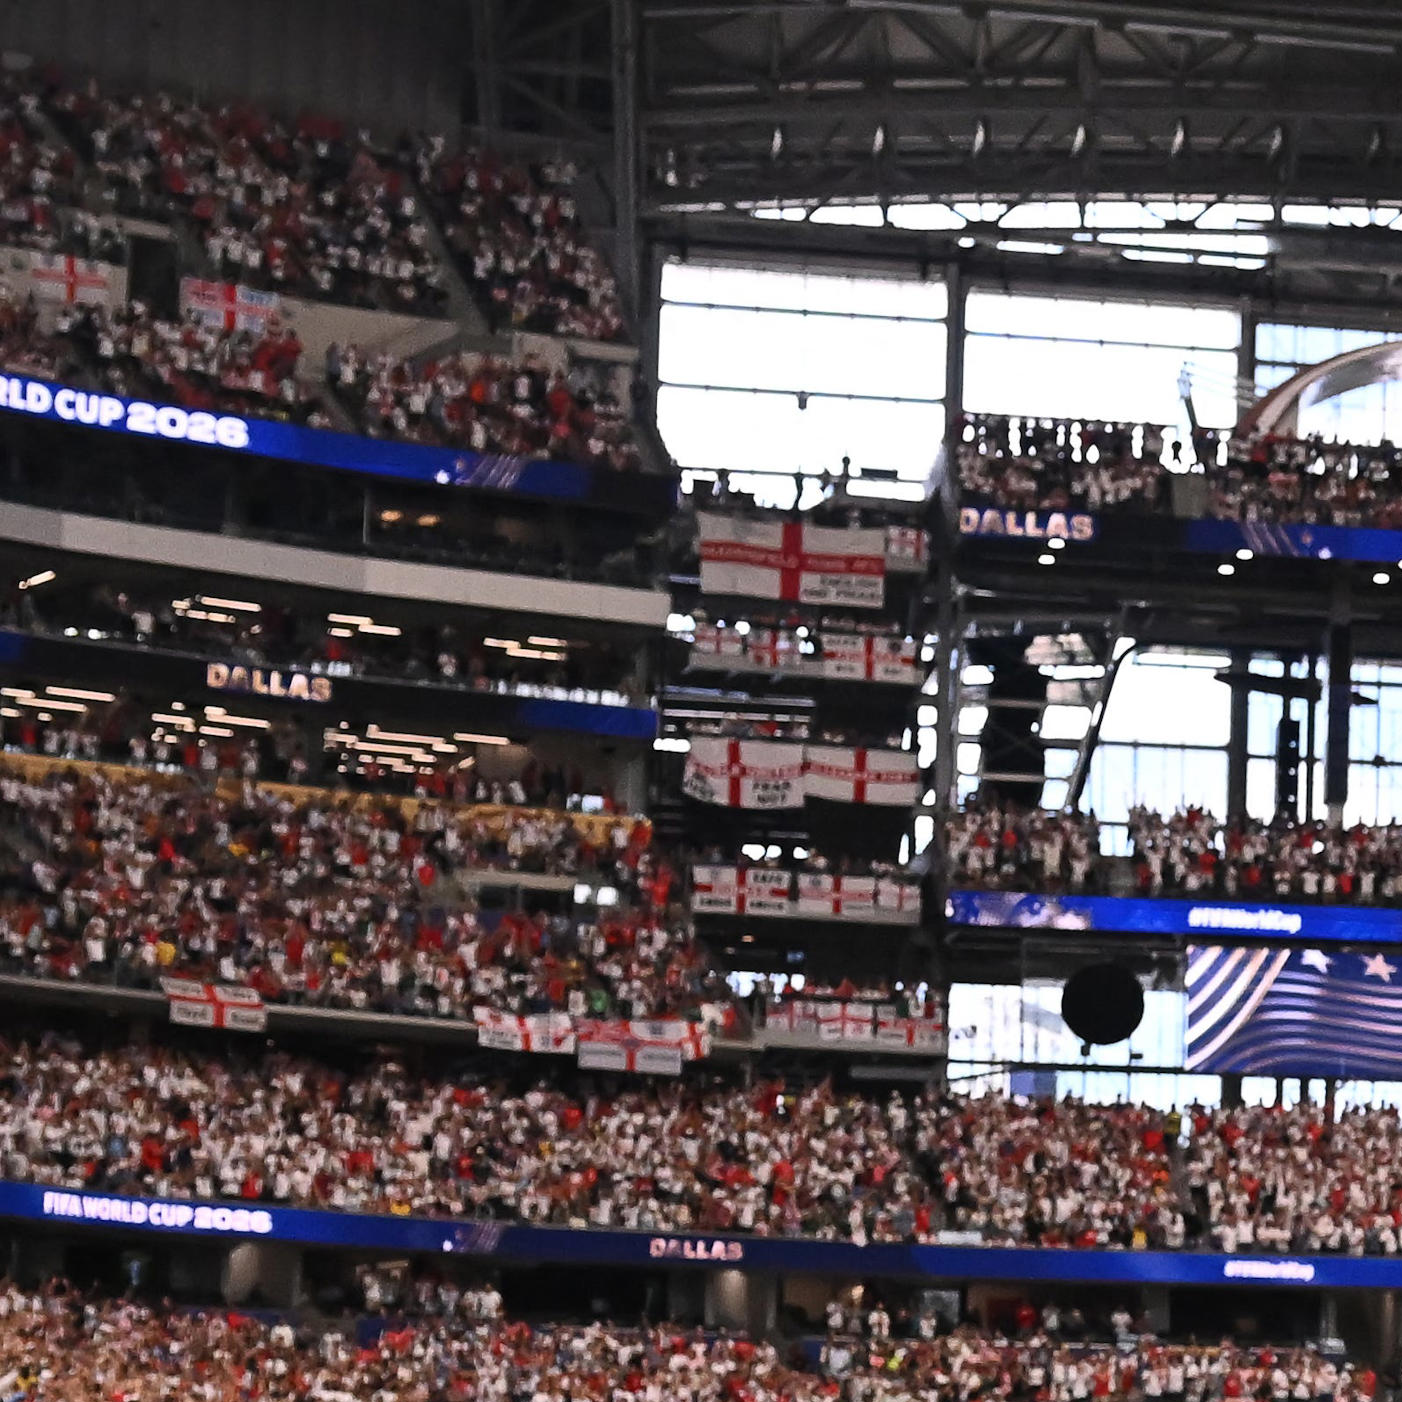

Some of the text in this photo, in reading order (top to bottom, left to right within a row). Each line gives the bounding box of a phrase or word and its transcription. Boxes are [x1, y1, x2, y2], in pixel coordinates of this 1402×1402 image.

[54, 389, 125, 427] CUP
[126, 402, 249, 448] 2026
[960, 507, 1093, 540] DALLAS
[207, 662, 332, 702] DALLAS
[43, 1191, 273, 1233] FIFA WORLD CUP 2026
